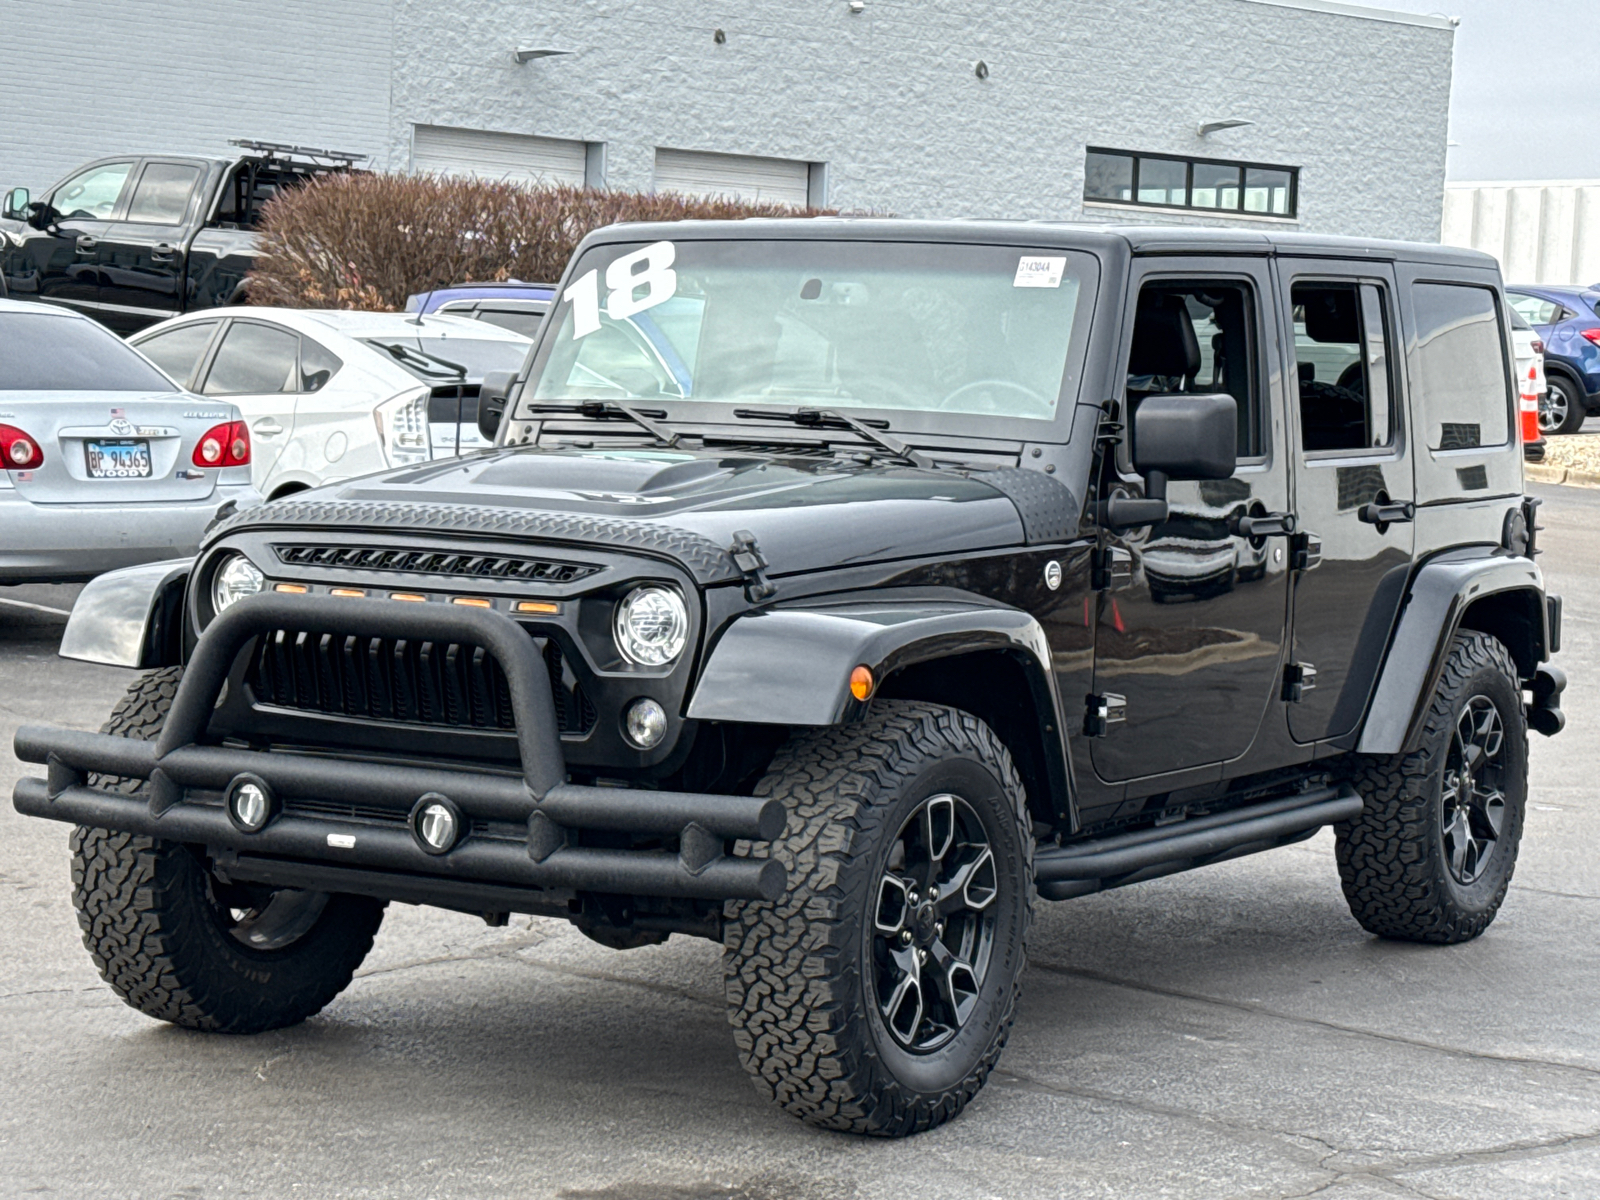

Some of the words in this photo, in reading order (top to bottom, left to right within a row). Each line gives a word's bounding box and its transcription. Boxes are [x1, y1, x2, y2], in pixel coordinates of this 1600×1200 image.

[563, 240, 677, 341] 18
[89, 450, 105, 469] BP
[110, 450, 149, 469] 94365
[91, 469, 149, 477] WOODY
